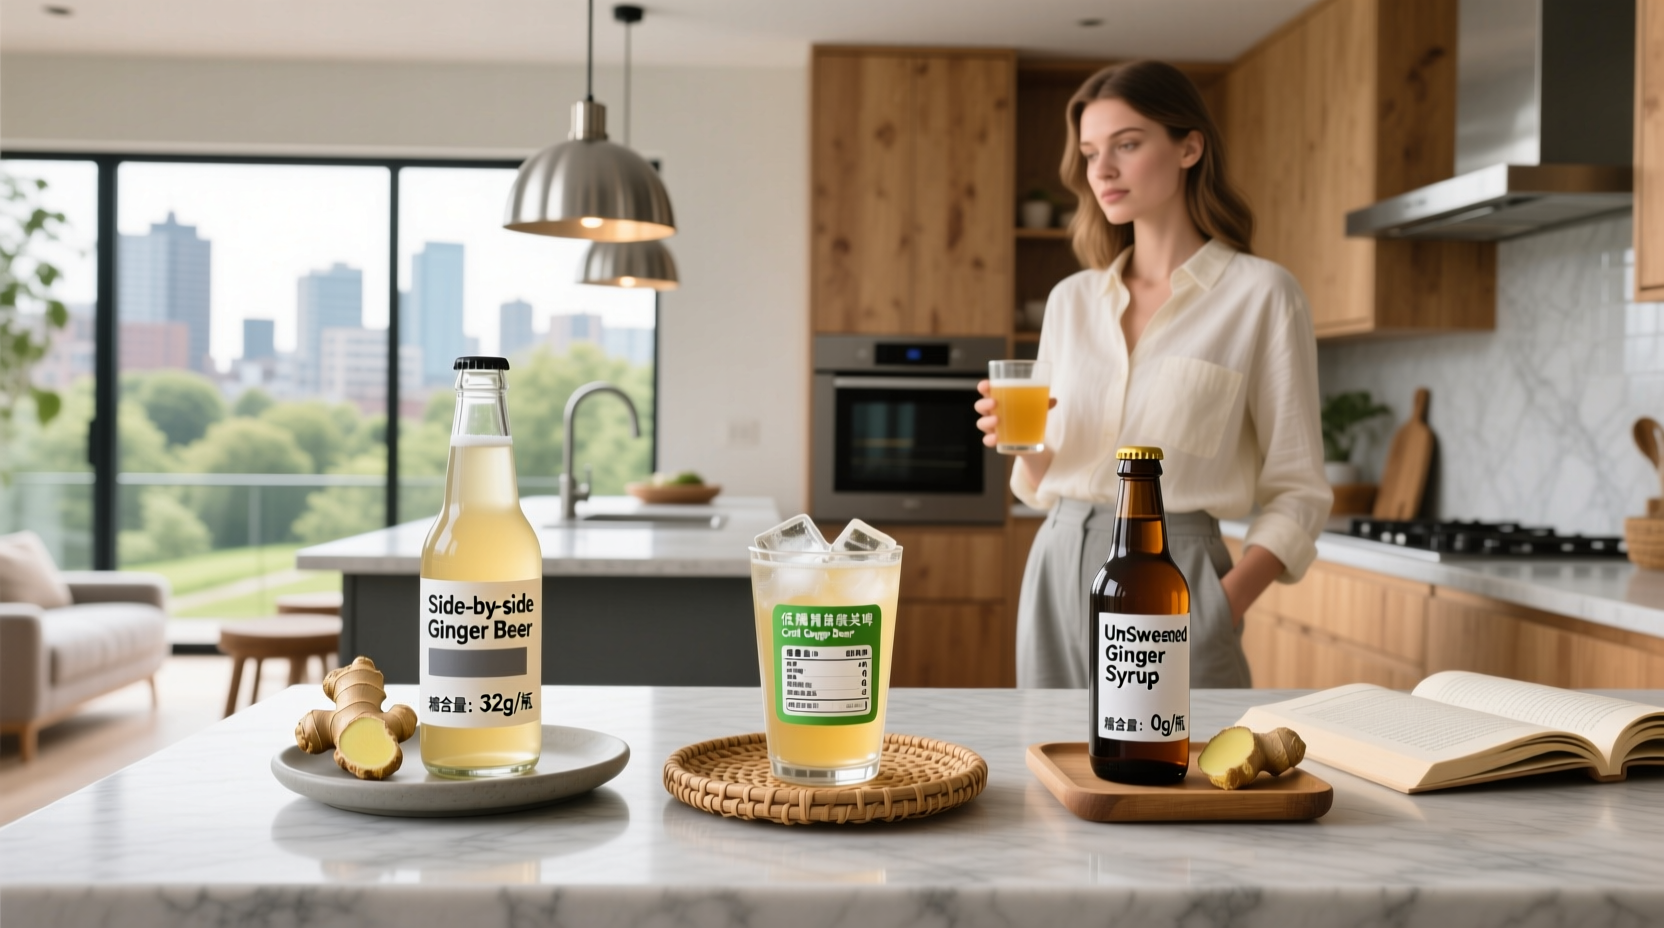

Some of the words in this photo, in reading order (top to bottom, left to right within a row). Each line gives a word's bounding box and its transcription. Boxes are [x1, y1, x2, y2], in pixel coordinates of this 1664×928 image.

[428, 593, 534, 620] Side-by-side
[428, 619, 489, 645] Ginger
[494, 620, 533, 639] Beer
[1105, 644, 1165, 667] Ginger
[1105, 664, 1159, 690] Syrup
